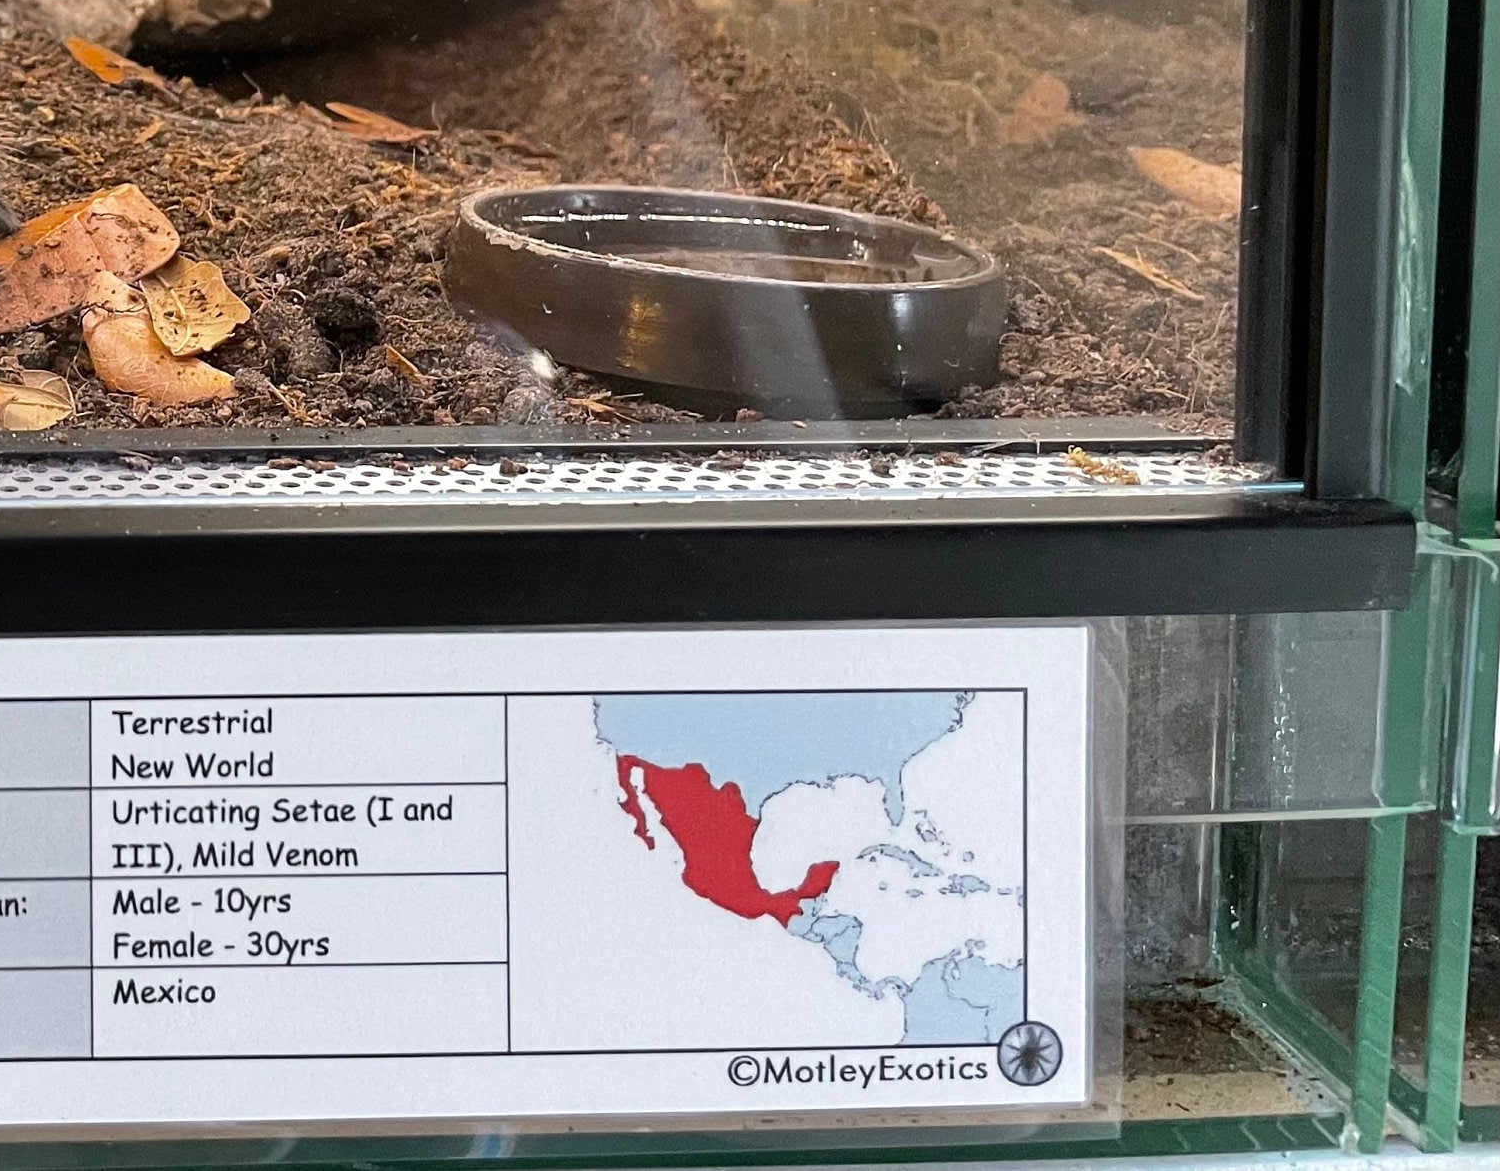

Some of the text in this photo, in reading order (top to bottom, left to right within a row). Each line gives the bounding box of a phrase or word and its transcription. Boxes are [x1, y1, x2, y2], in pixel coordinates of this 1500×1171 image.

[111, 707, 273, 735] Terrestrial
[111, 751, 274, 780] New World
[112, 794, 453, 831] Urticating Setae (I and
[112, 841, 359, 874] III), Mild Venom
[112, 887, 181, 915] Male
[215, 887, 291, 921] 10yrs
[113, 931, 214, 960] Female
[247, 930, 330, 963] 30yrs
[113, 978, 216, 1005] Mexico
[727, 1054, 988, 1089] ©MotleyExotics
